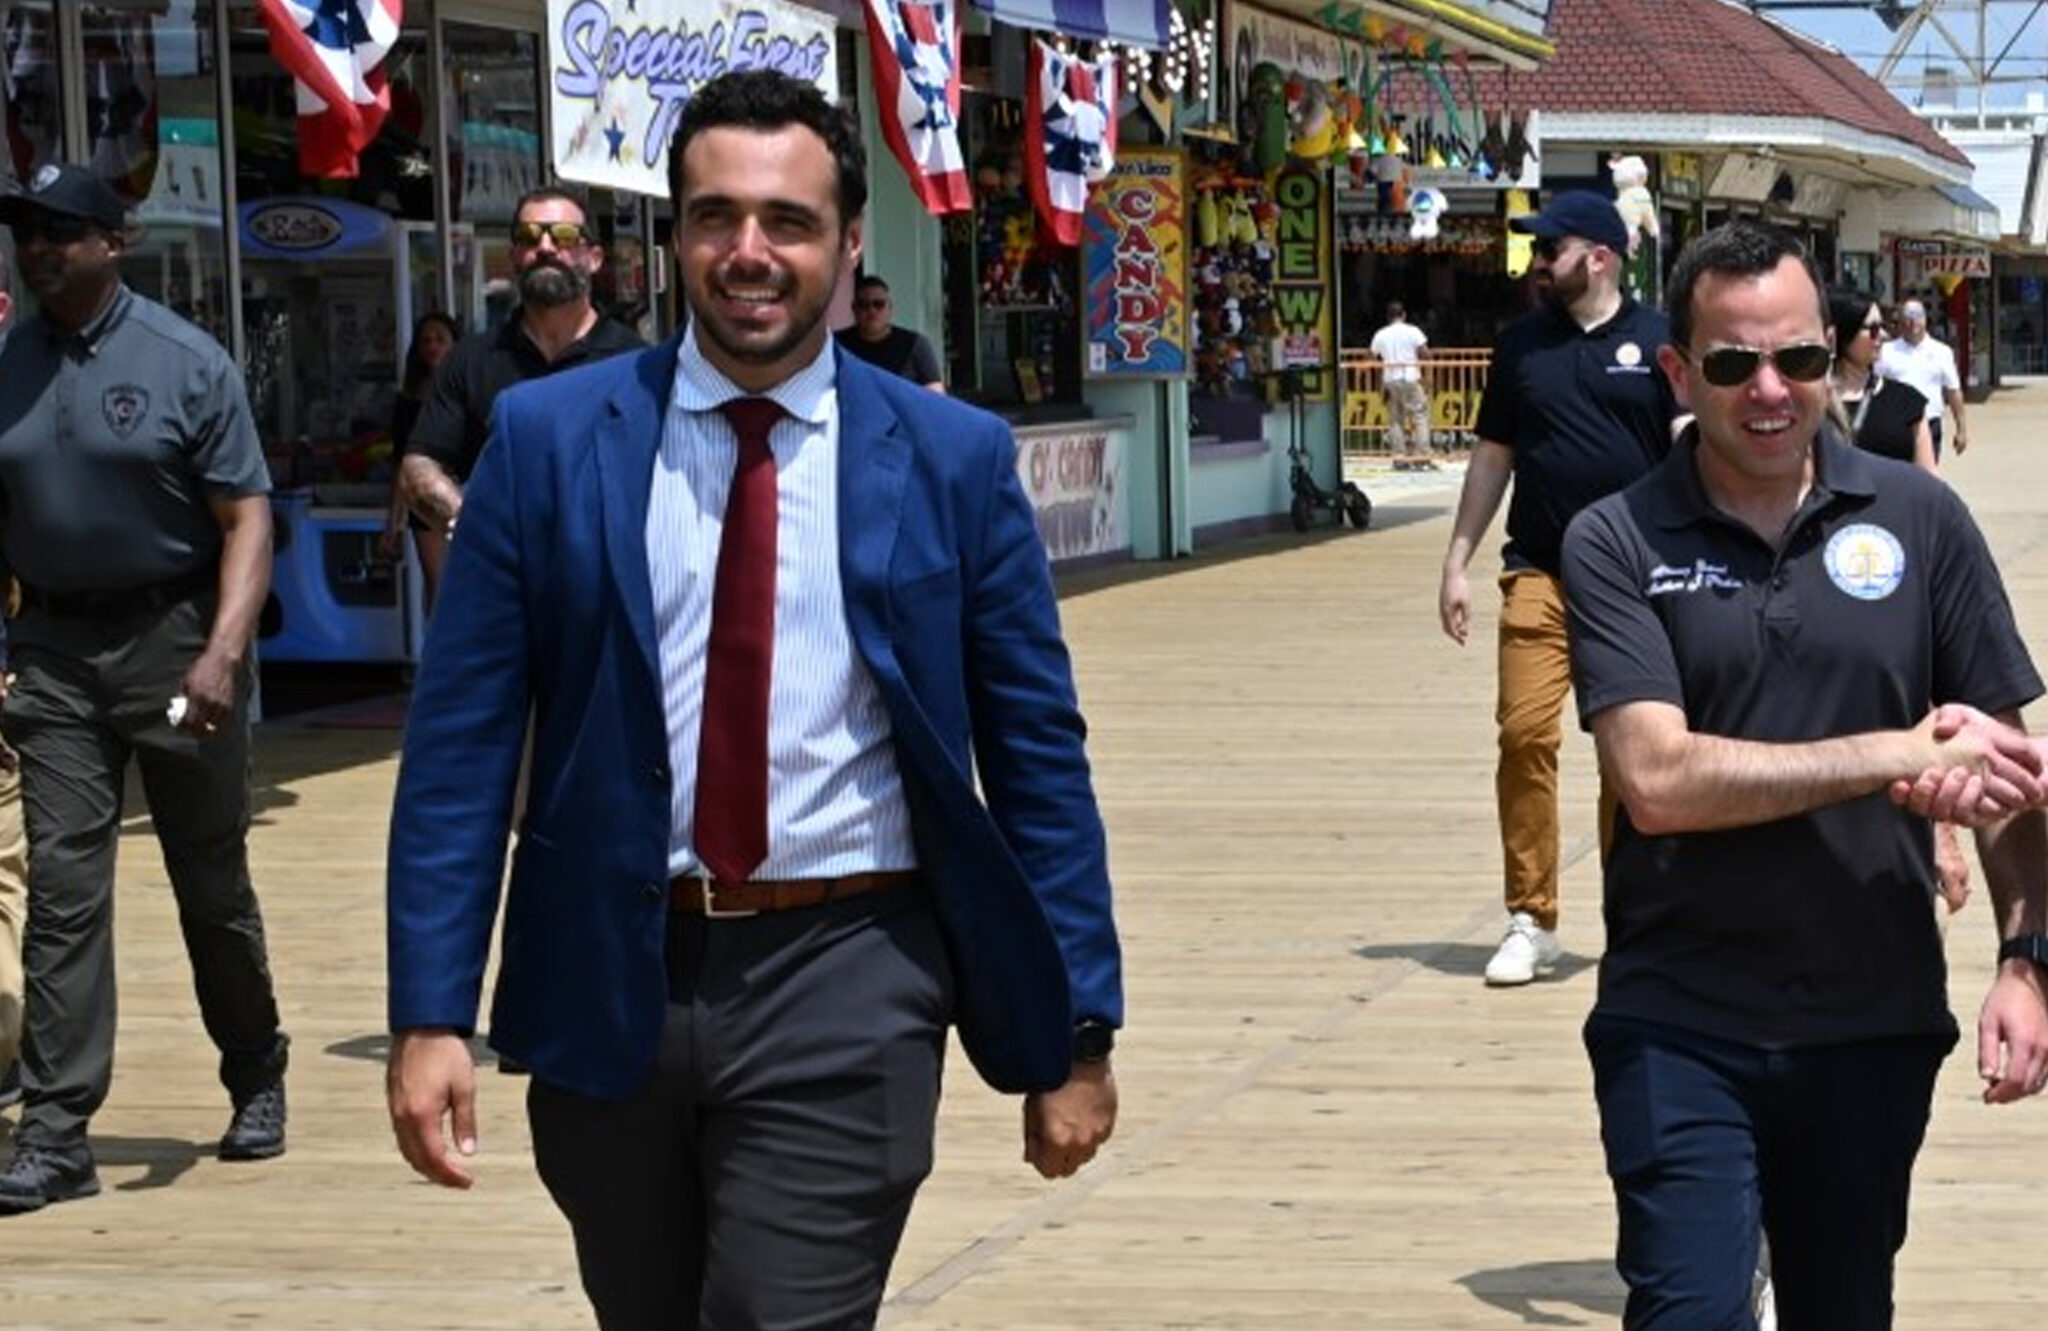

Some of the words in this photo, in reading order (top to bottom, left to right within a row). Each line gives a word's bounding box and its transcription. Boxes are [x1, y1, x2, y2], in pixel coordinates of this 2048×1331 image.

[555, 0, 727, 98] Special
[727, 10, 830, 81] Event
[1114, 188, 1163, 362] CANDY
[1276, 171, 1321, 280] ONE
[1924, 257, 1988, 273] PIZZA
